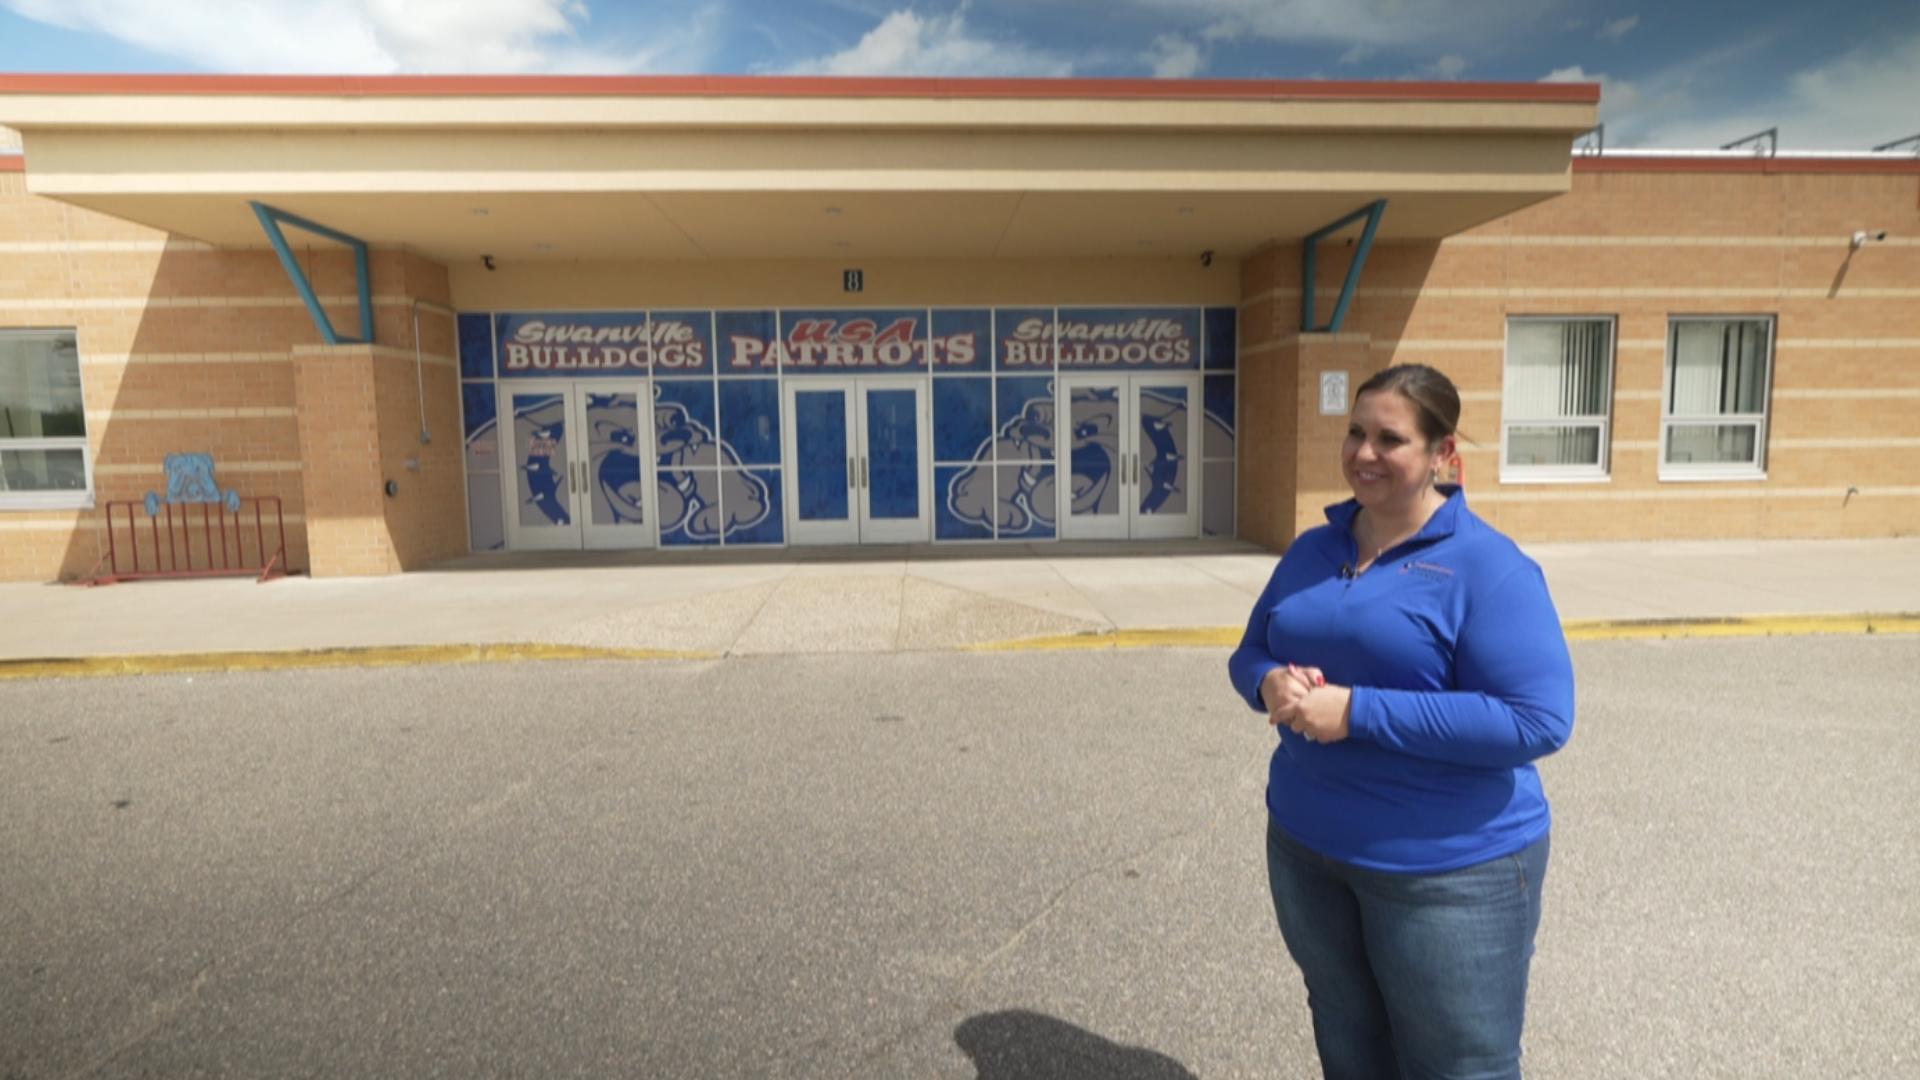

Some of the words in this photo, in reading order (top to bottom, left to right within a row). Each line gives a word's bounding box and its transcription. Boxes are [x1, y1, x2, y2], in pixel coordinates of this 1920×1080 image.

[847, 271, 860, 290] 8
[513, 320, 694, 344] Swanville
[789, 318, 917, 346] USA
[1012, 318, 1184, 342] Swanville
[506, 340, 704, 369] BULLDOGS
[730, 332, 977, 367] PATRIOTS
[1004, 338, 1191, 366] BULLDOGS
